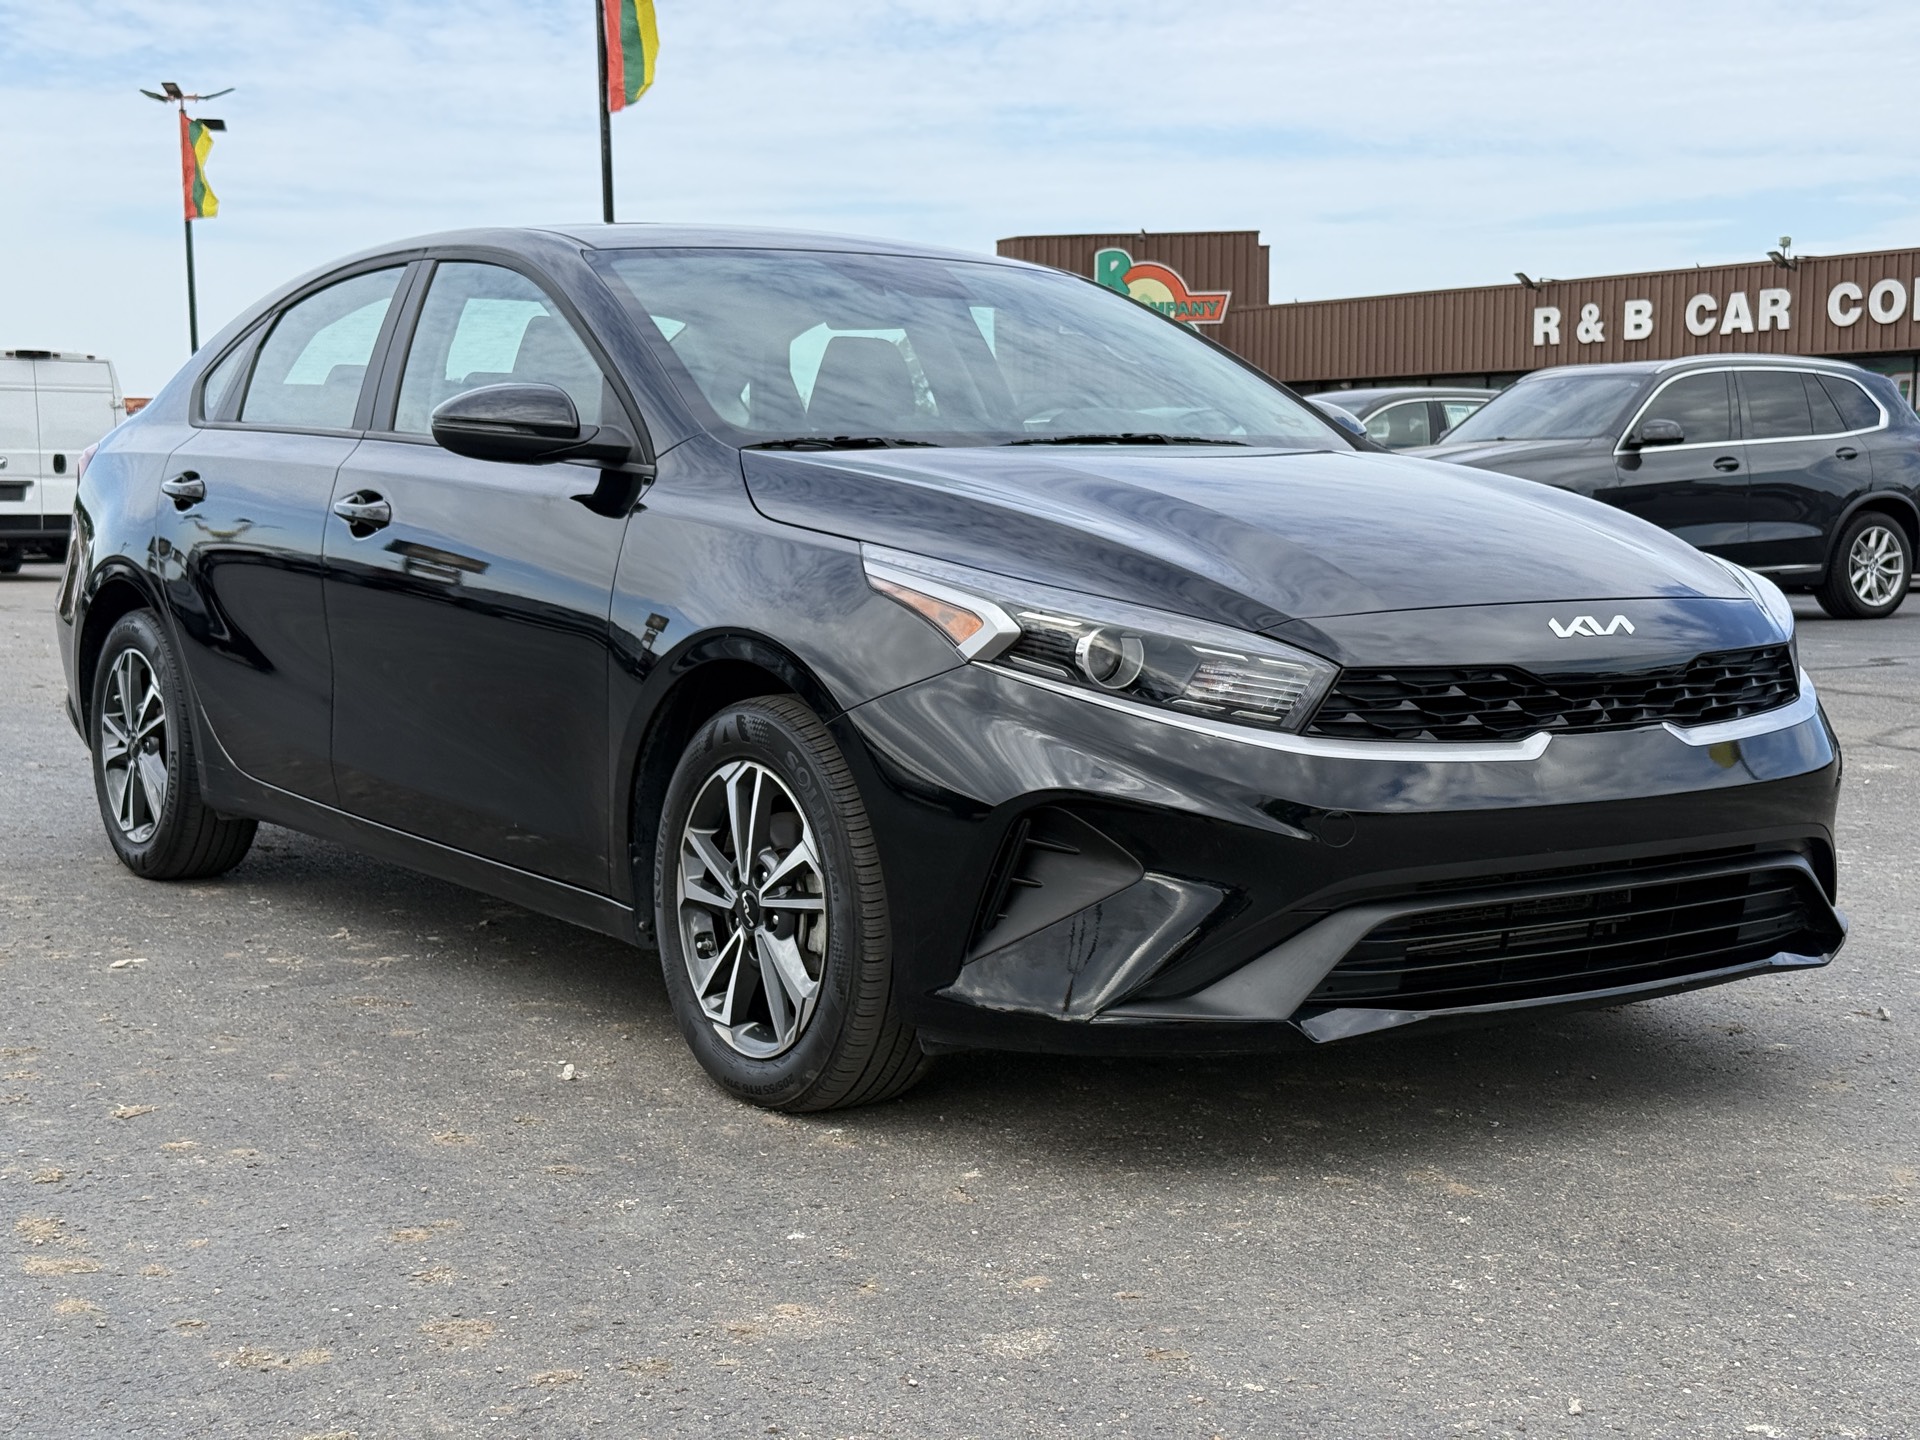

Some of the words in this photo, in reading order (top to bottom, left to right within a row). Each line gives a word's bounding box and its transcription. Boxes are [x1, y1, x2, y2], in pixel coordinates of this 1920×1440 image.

[1150, 301, 1219, 318] MPANY
[1532, 306, 1562, 347] R
[1576, 302, 1606, 345] &
[1623, 299, 1654, 341] B
[1684, 287, 1792, 337] CAR
[1547, 614, 1636, 638] KIA
[653, 798, 673, 909] KUMHO
